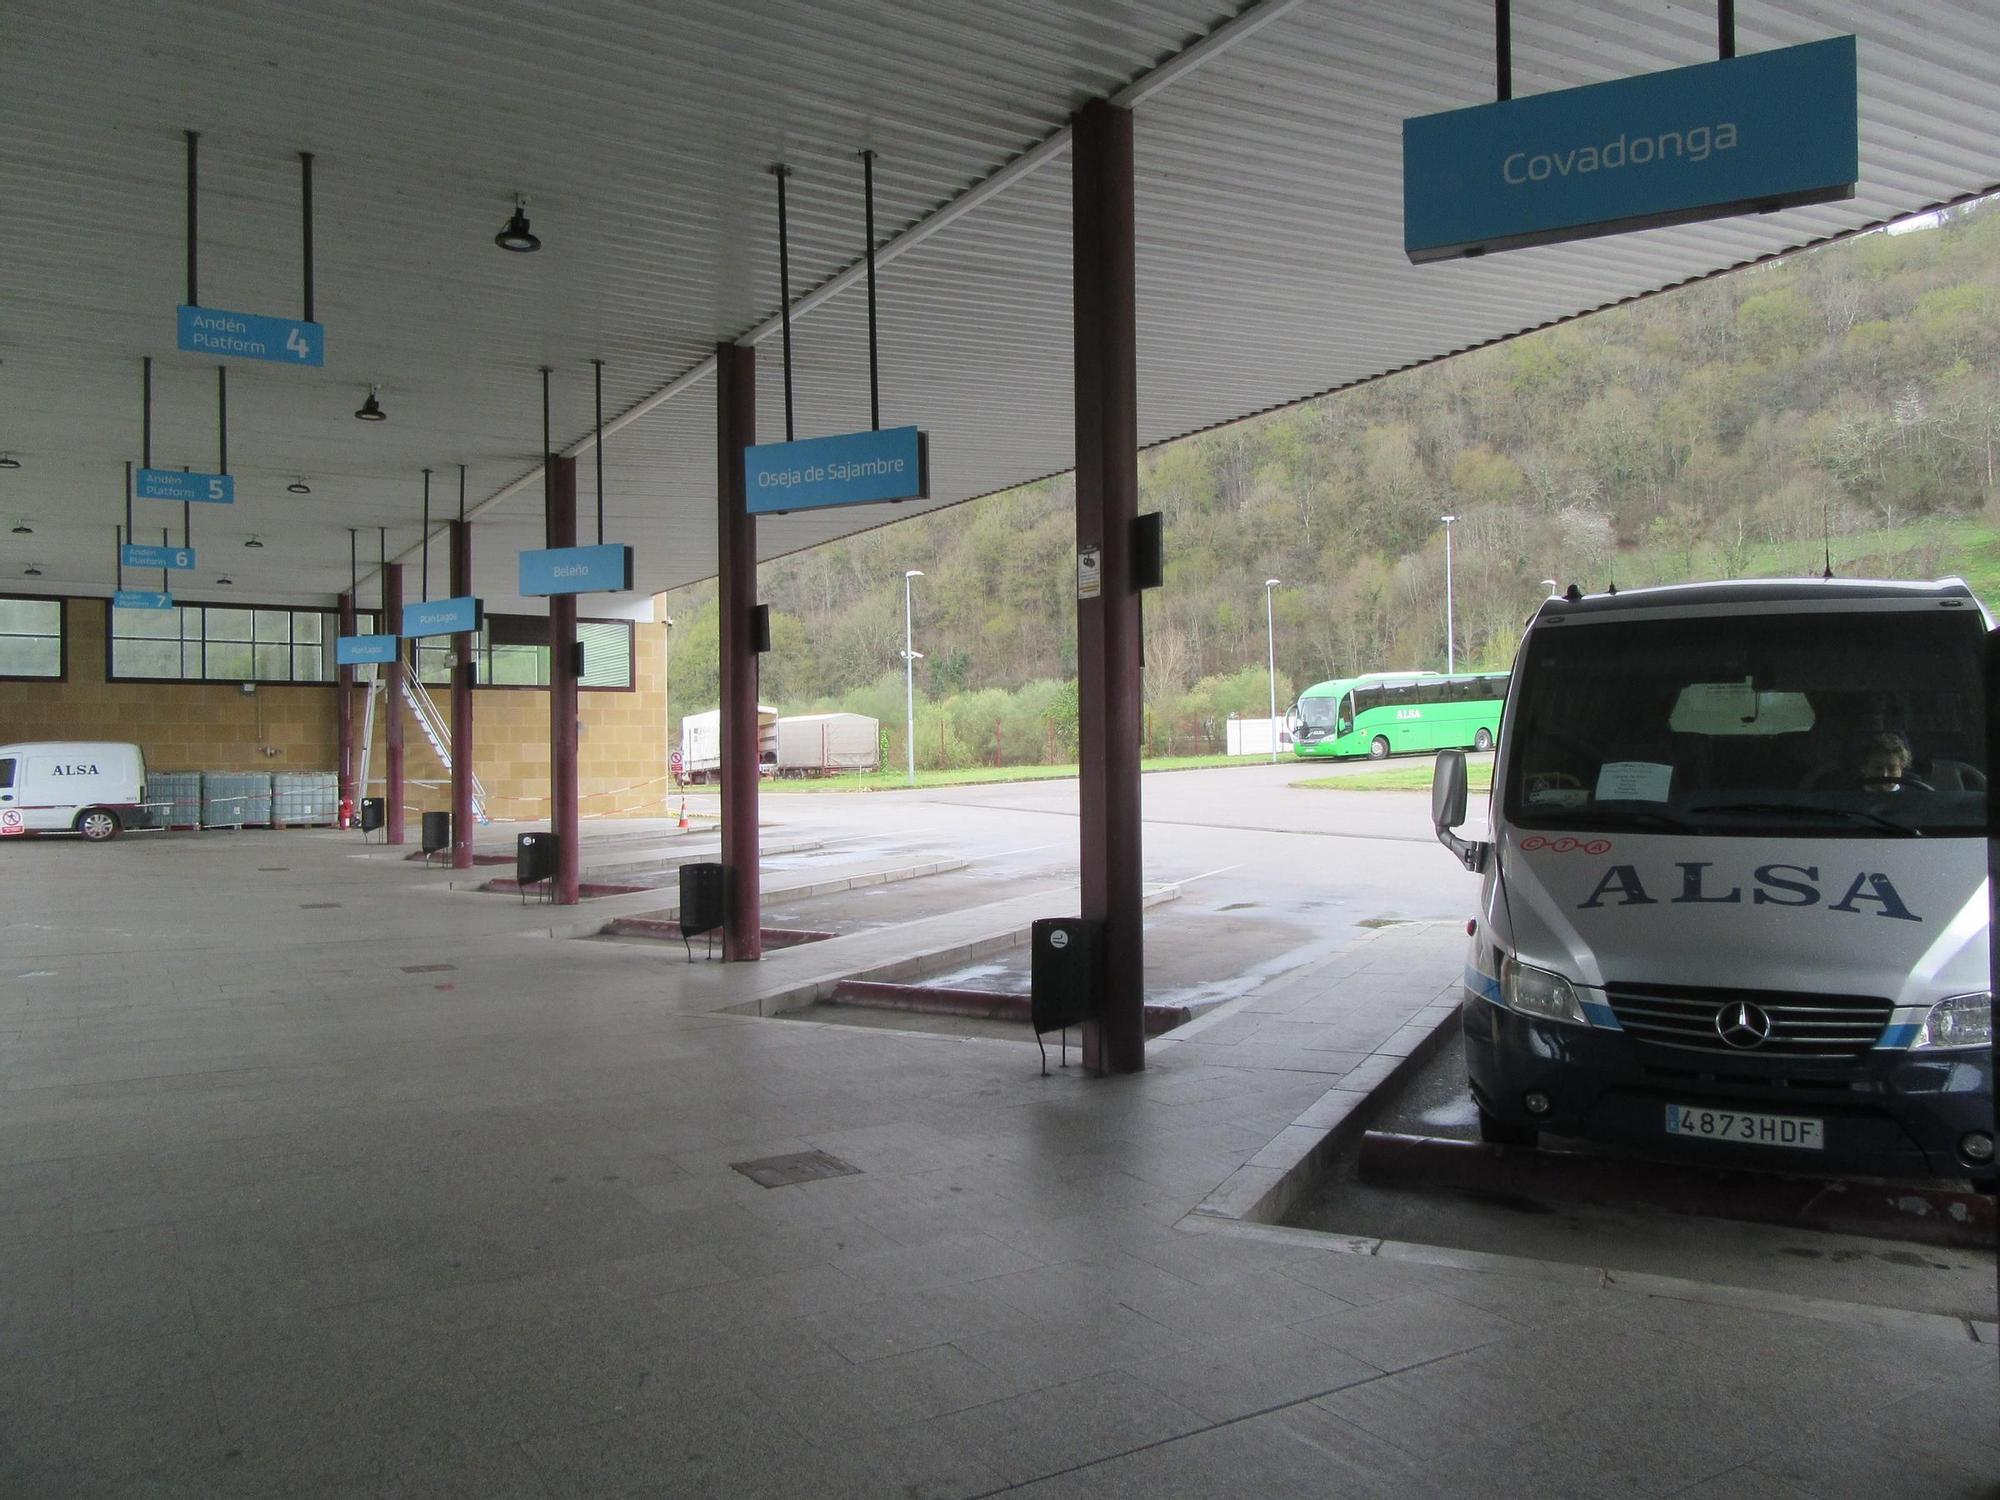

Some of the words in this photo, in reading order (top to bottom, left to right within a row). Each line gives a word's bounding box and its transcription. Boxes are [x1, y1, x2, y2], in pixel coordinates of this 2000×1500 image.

[1502, 122, 1738, 185] Covadonga
[193, 314, 246, 334] Andén
[193, 333, 265, 355] Platform
[286, 328, 310, 358] 4
[758, 469, 801, 488] Oseja
[804, 466, 825, 483] de
[827, 458, 904, 481] Sajambre
[146, 485, 195, 498] Platform
[208, 479, 224, 500] 5
[175, 551, 188, 567] 6
[553, 564, 590, 578] Beleño
[156, 594, 167, 607] 7
[1396, 708, 1421, 719] ALSA
[52, 764, 100, 776] ALSA
[1576, 861, 1923, 922] ALSA
[1680, 1110, 1816, 1144] 4873HDF
